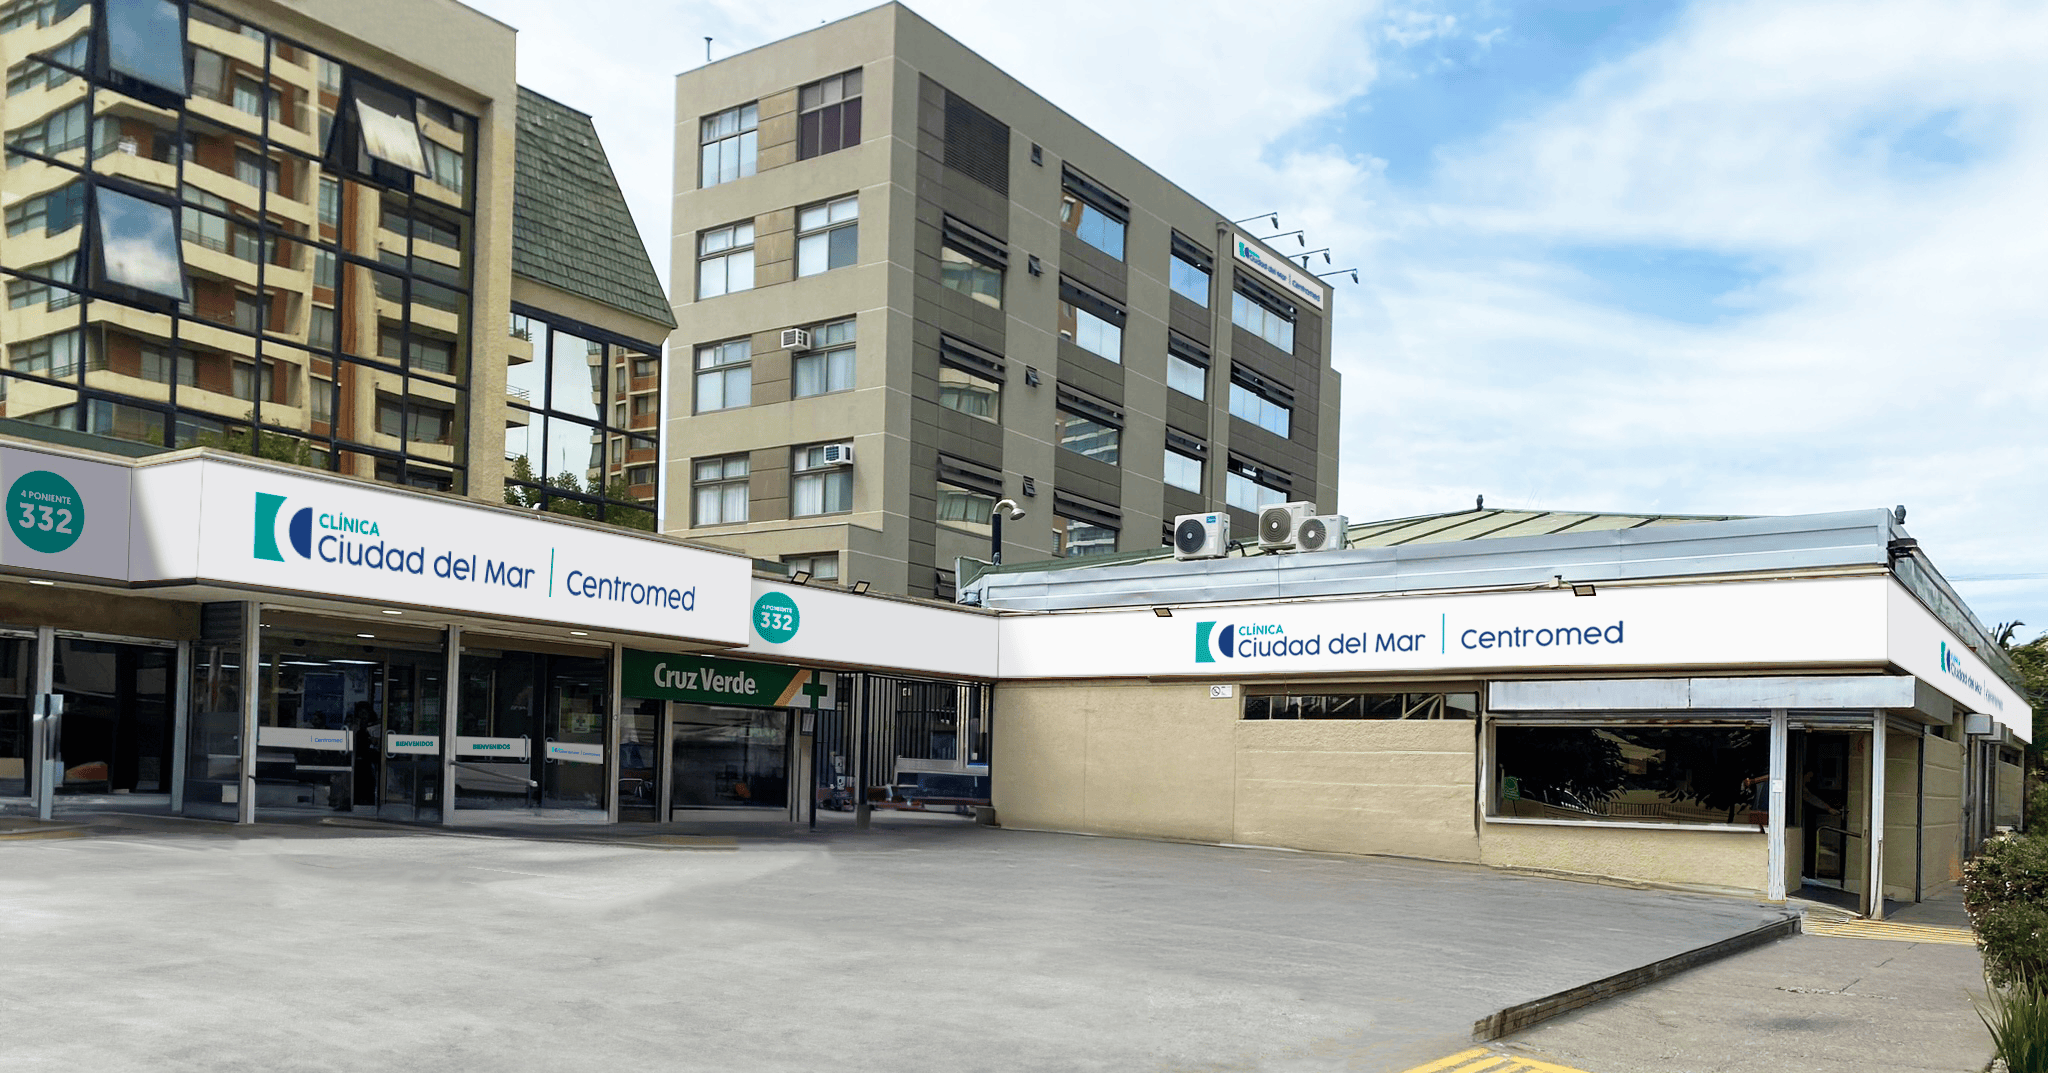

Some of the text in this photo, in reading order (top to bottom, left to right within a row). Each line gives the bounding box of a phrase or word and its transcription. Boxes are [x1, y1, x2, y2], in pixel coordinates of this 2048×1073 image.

[21, 490, 72, 505] 4 PONIENTE
[19, 502, 72, 534] 332
[319, 512, 380, 537] CLÍNICA
[318, 534, 695, 612] Ciudad del Mar Centromed
[761, 612, 792, 631] 332
[1239, 623, 1284, 637] CLÍNICA
[1238, 634, 1320, 659] Ciudad
[1328, 632, 1367, 655] del
[1375, 632, 1426, 654] Mar
[654, 662, 698, 690] Cruz
